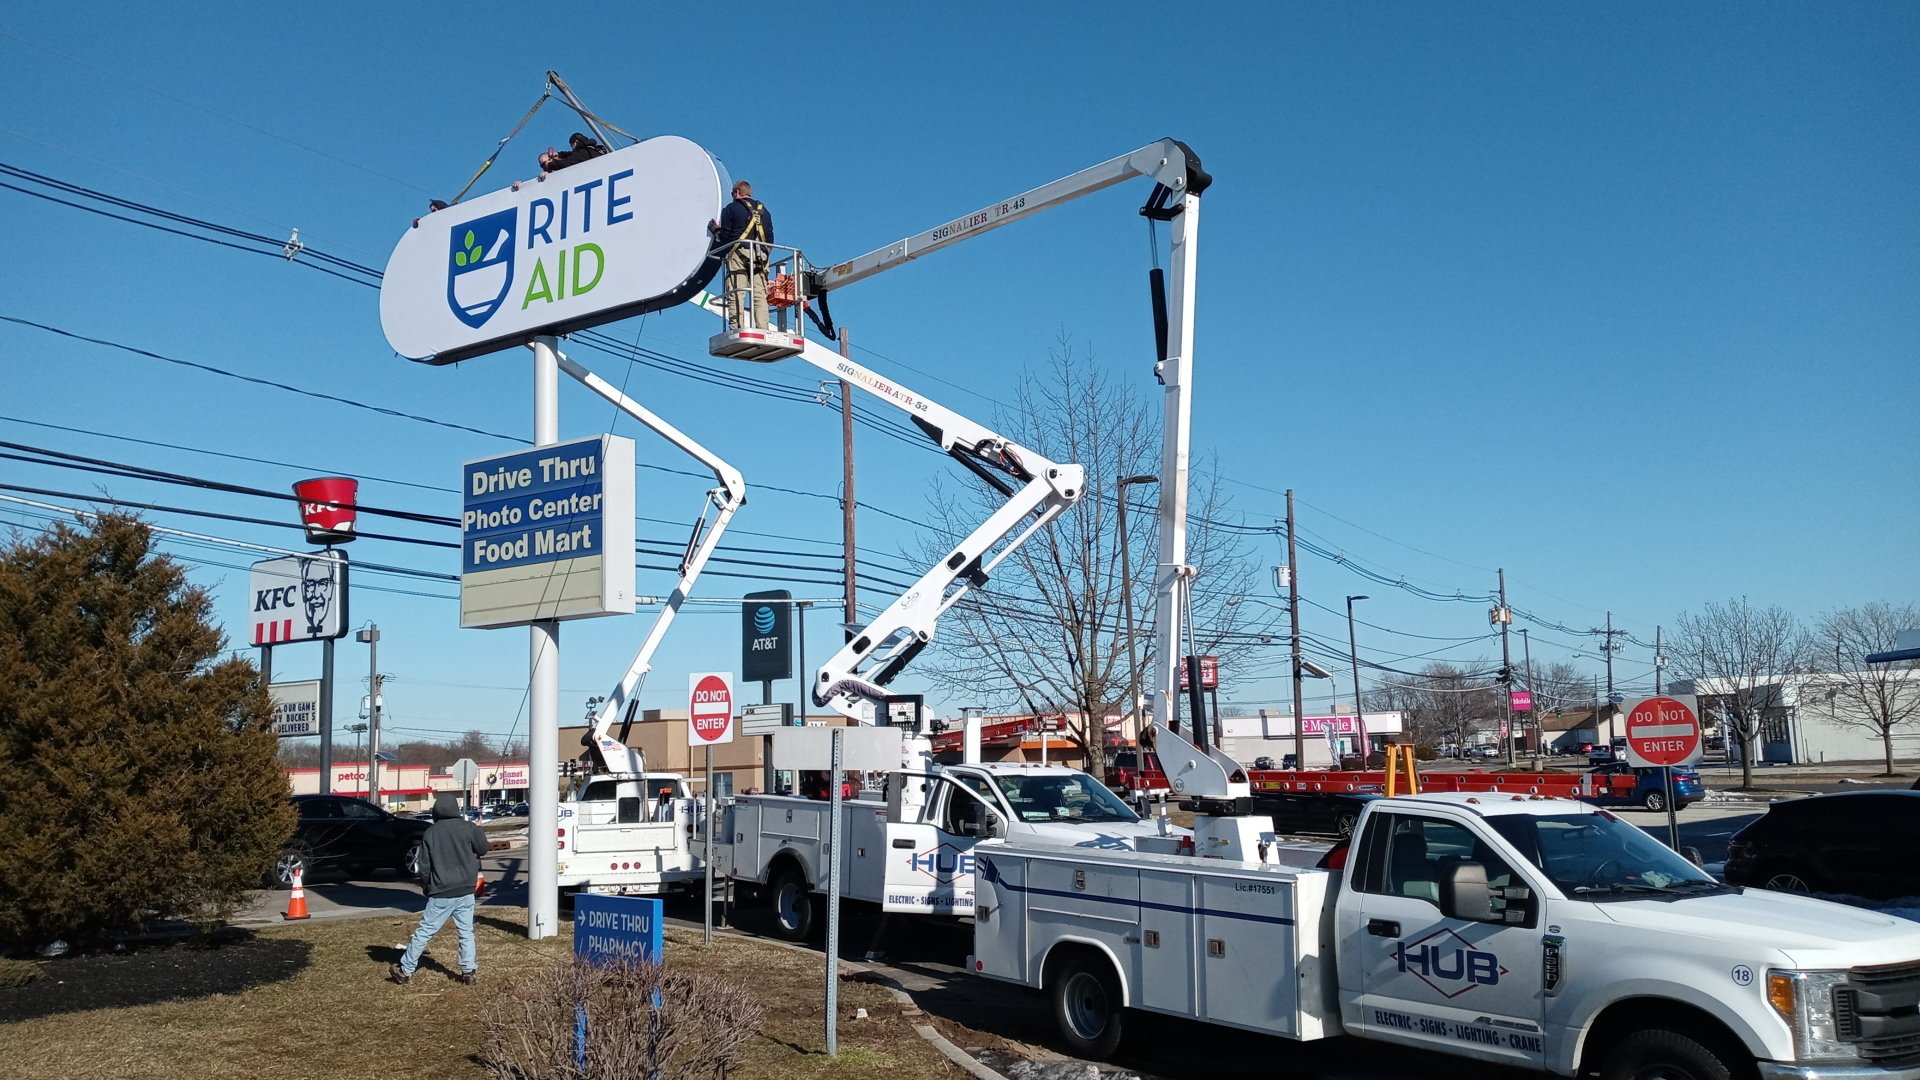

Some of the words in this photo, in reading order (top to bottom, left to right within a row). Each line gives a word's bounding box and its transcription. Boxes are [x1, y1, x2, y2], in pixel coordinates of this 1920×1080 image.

[527, 168, 634, 250] RITE
[932, 212, 988, 241] SIGNALIER
[994, 197, 1025, 218] TR-43
[521, 242, 605, 310] AID
[836, 362, 893, 395] SIGNALIER
[472, 467, 532, 496] Drive
[539, 455, 595, 483] Thru
[464, 504, 522, 532] Photo
[528, 492, 602, 521] Center
[473, 533, 529, 565] Food
[535, 524, 592, 556] Mart
[254, 585, 297, 612] KFC
[752, 636, 778, 651] AT&T
[696, 690, 709, 702] DO
[710, 689, 727, 701] NOT
[696, 717, 725, 731] ENTER
[1310, 719, 1349, 731] Moble
[1635, 711, 1653, 723] DO
[1660, 709, 1686, 722] NOT
[1643, 740, 1685, 753] ENTER
[338, 772, 366, 782] petco
[558, 809, 573, 818] UB
[888, 894, 915, 905] ELECTRIC
[920, 896, 939, 906] SIGNS
[945, 897, 974, 907] LIGHTING
[588, 910, 619, 930] DRIVE
[620, 913, 649, 934] THRU
[588, 934, 647, 958] PHARMACY
[1397, 941, 1499, 986] HUB
[1734, 968, 1750, 982] 18
[1375, 1010, 1412, 1030] ELECTRIC
[1420, 1018, 1447, 1036] SIGNS
[1455, 1024, 1500, 1045] LIGHTING
[1508, 1033, 1541, 1053] CRANE
